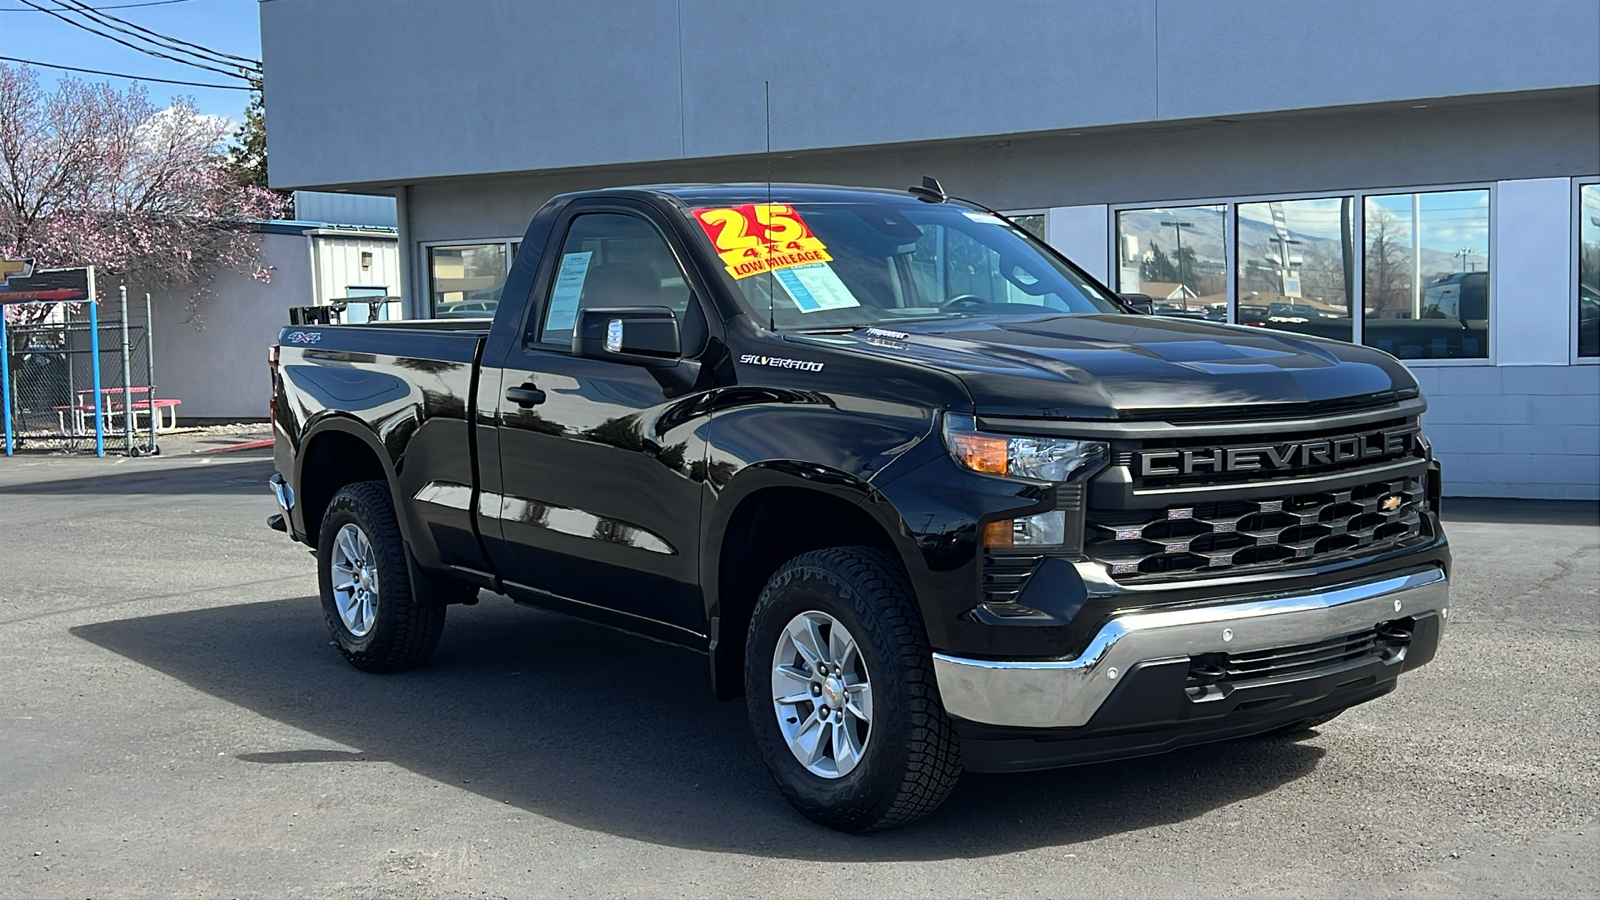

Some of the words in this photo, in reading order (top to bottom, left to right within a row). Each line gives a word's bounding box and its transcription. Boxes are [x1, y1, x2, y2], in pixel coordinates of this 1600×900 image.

[700, 205, 806, 250] 25
[733, 260, 764, 276] LOW
[766, 250, 824, 269] MILEAGE
[739, 354, 825, 372] SILVERADO
[1141, 428, 1420, 476] CHEVROLET
